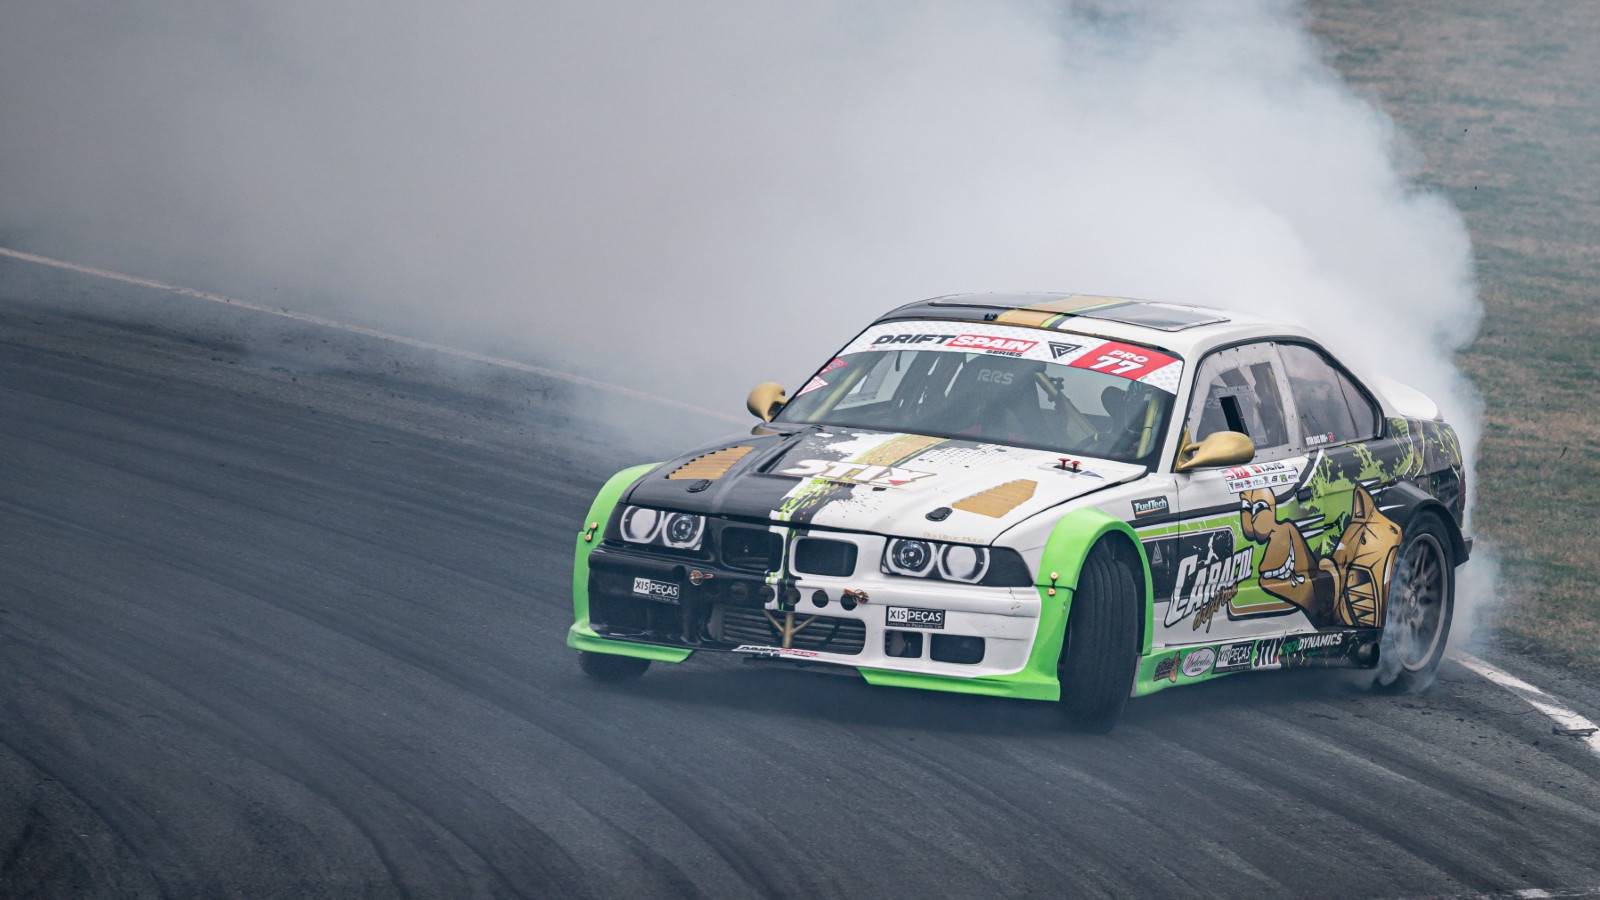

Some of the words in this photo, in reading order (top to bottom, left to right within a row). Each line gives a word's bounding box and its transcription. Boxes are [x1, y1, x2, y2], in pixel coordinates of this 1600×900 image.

[872, 334, 957, 345] DRIFT
[951, 335, 1035, 352] SPAIN
[985, 349, 1024, 357] SERIES
[1108, 349, 1149, 363] PRO
[1088, 355, 1145, 374] 77
[1134, 498, 1167, 512] FuelTech
